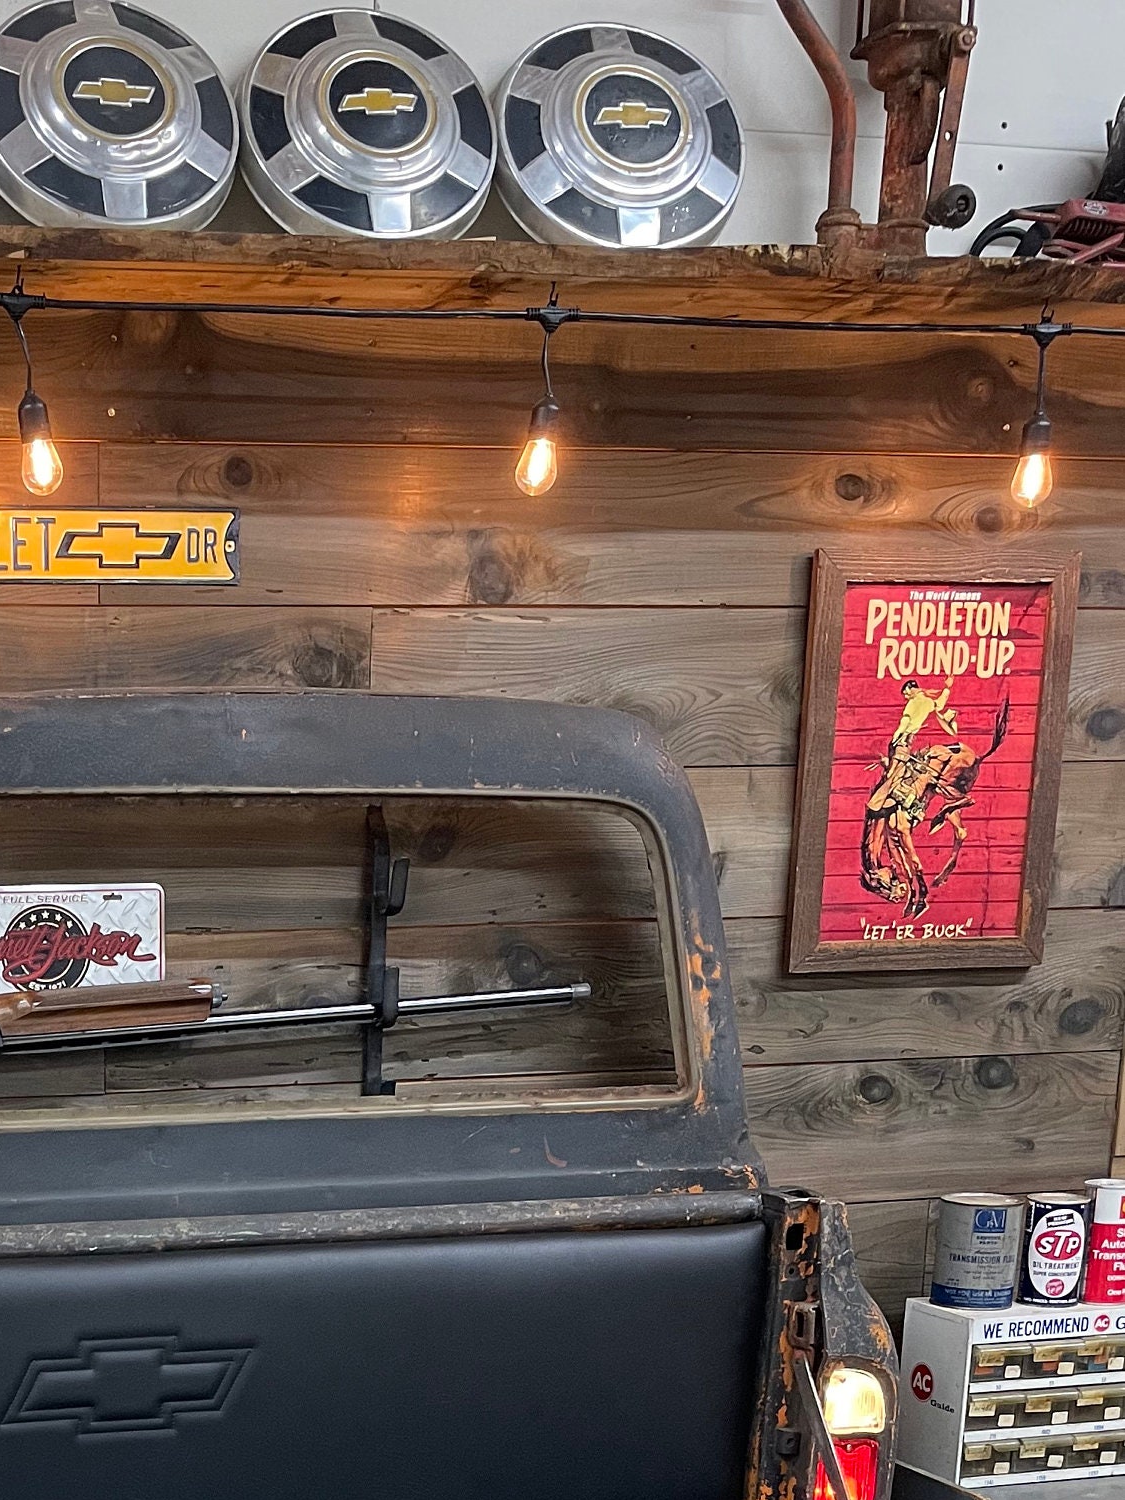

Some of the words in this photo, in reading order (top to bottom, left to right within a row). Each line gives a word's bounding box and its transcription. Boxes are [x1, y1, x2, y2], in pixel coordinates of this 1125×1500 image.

[187, 527, 218, 564] DR
[909, 591, 923, 600] The
[925, 591, 949, 600] World
[950, 591, 982, 601] Famous
[865, 599, 1012, 645] PENDLETON
[3, 895, 33, 904] FULL
[37, 894, 88, 904] SERVICE
[28, 981, 46, 991] EST
[48, 980, 67, 990] 1971
[1037, 1231, 1080, 1258] STP
[949, 1252, 1001, 1264] TRANSMISSION
[1033, 1261, 1042, 1269] OIL
[1044, 1261, 1080, 1270] TREATMENT
[983, 1323, 1003, 1339] WE
[1008, 1316, 1089, 1338] RECOMMEND
[1094, 1317, 1109, 1328] AC
[912, 1372, 931, 1393] AC
[931, 1400, 955, 1414] Guide
